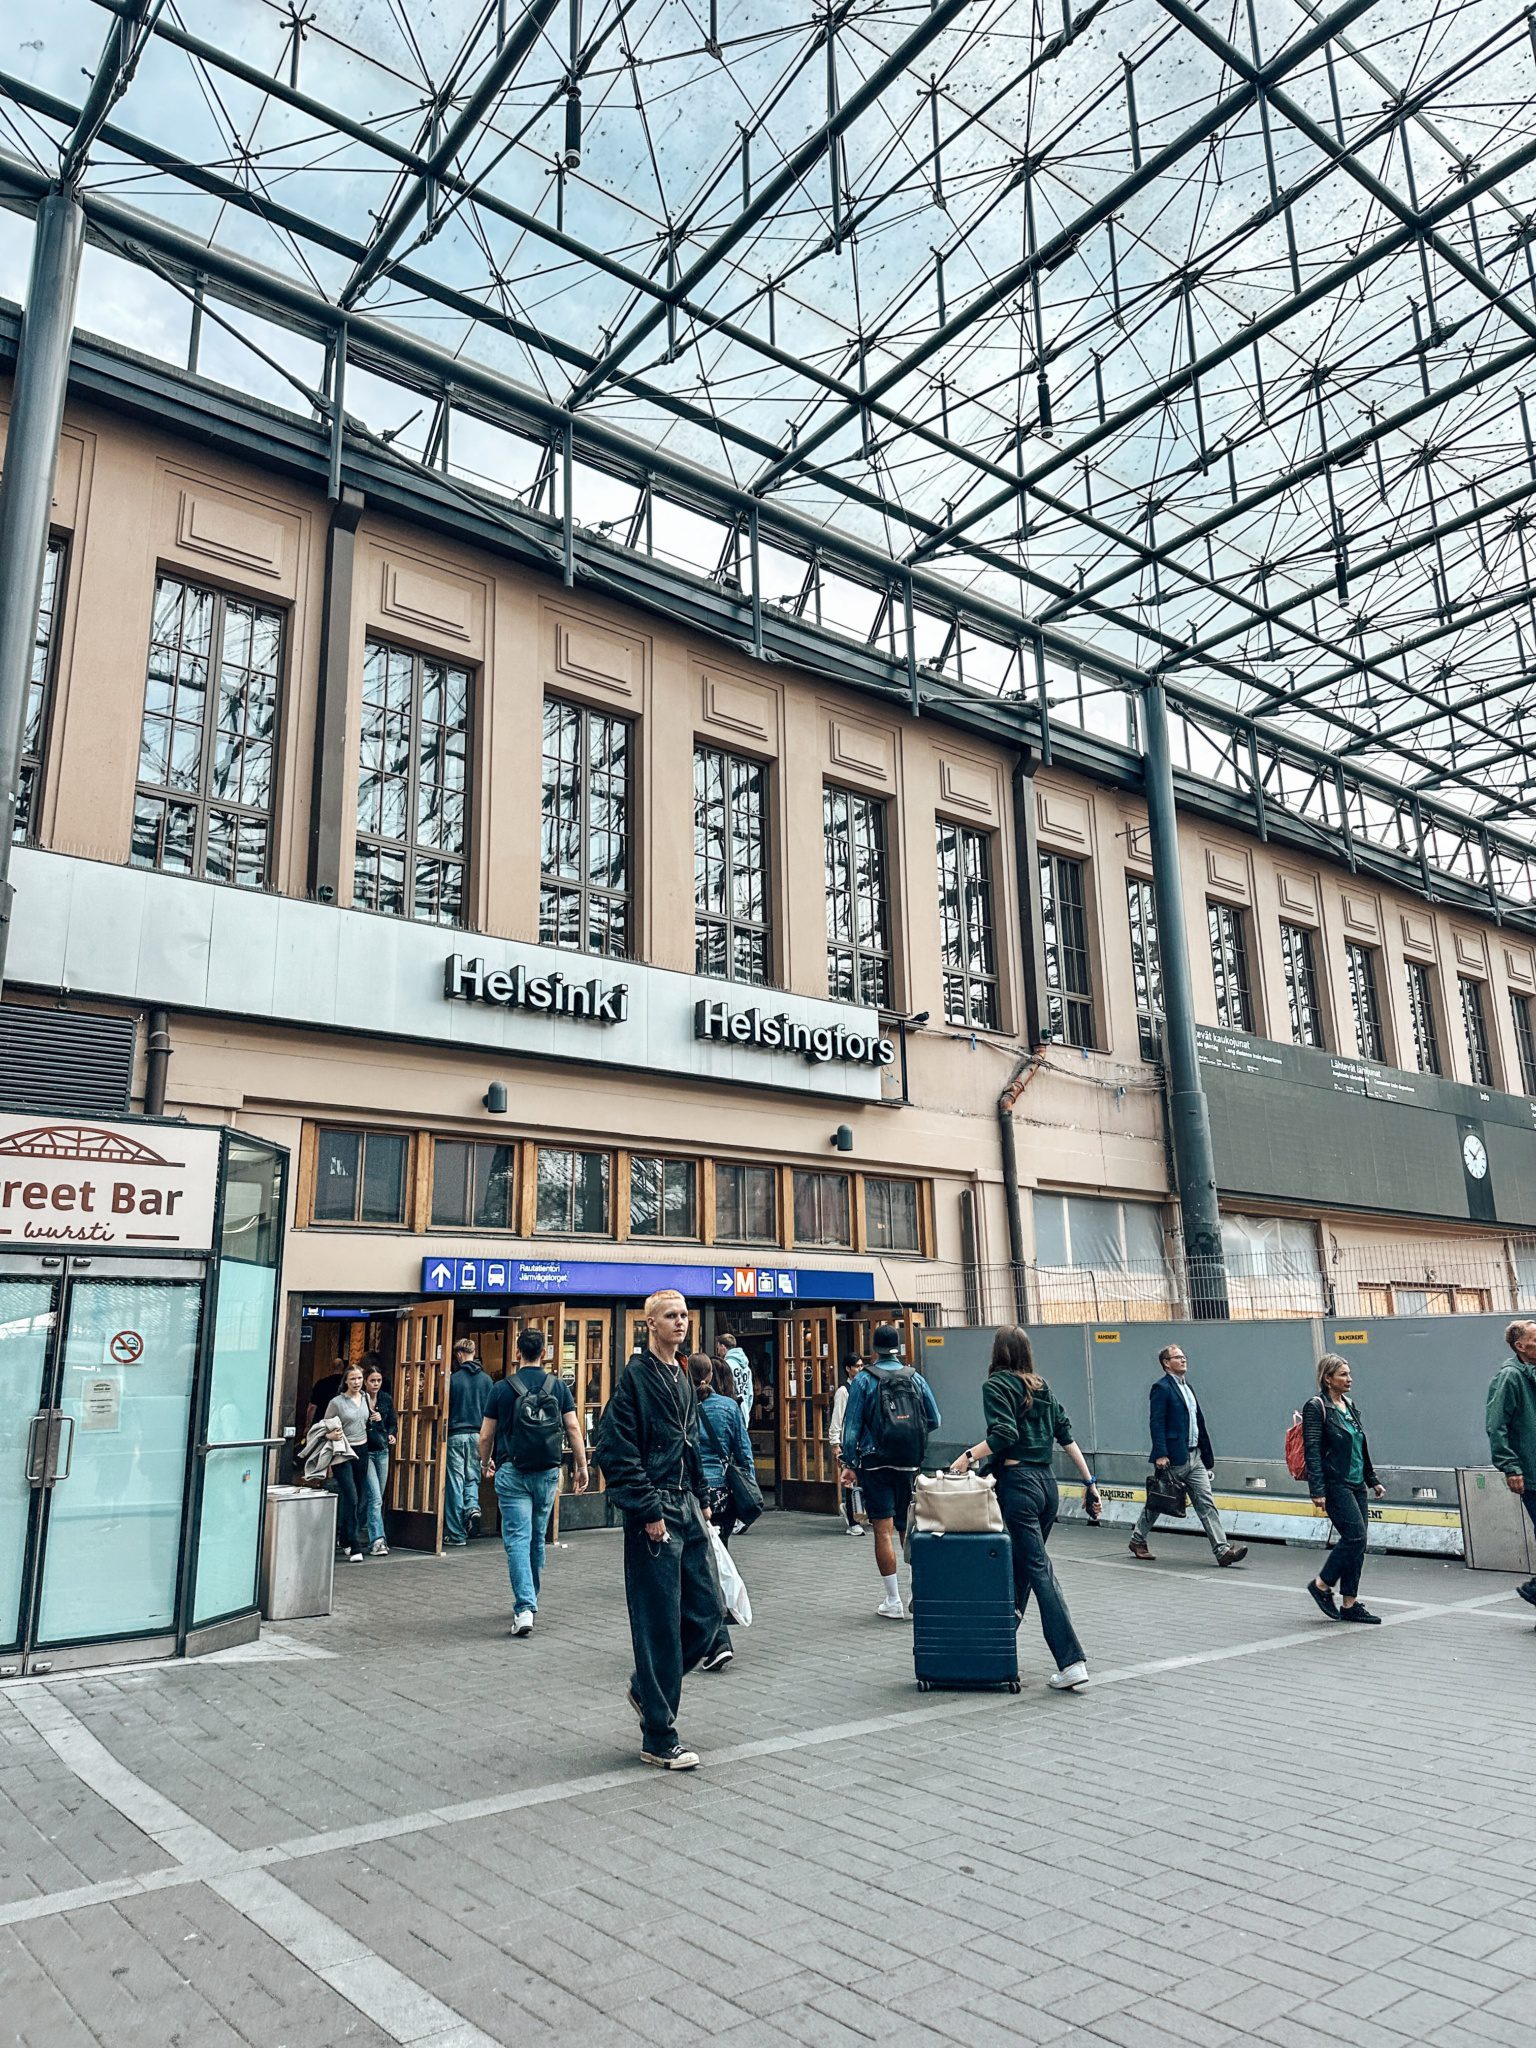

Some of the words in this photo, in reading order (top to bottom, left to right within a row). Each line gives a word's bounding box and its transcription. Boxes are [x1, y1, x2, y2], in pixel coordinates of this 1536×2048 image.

[446, 954, 629, 1022] Helsinki
[696, 1000, 896, 1064] Helsingfors
[1330, 1059, 1356, 1073] Lähtevät
[0, 1181, 96, 1213] reet
[111, 1182, 183, 1216] Bar
[24, 1221, 115, 1242] wursti
[519, 1263, 560, 1273] Rautatientori
[736, 1271, 755, 1293] M
[1100, 1489, 1134, 1499] RAMIRENT
[1367, 1510, 1382, 1519] ENT
